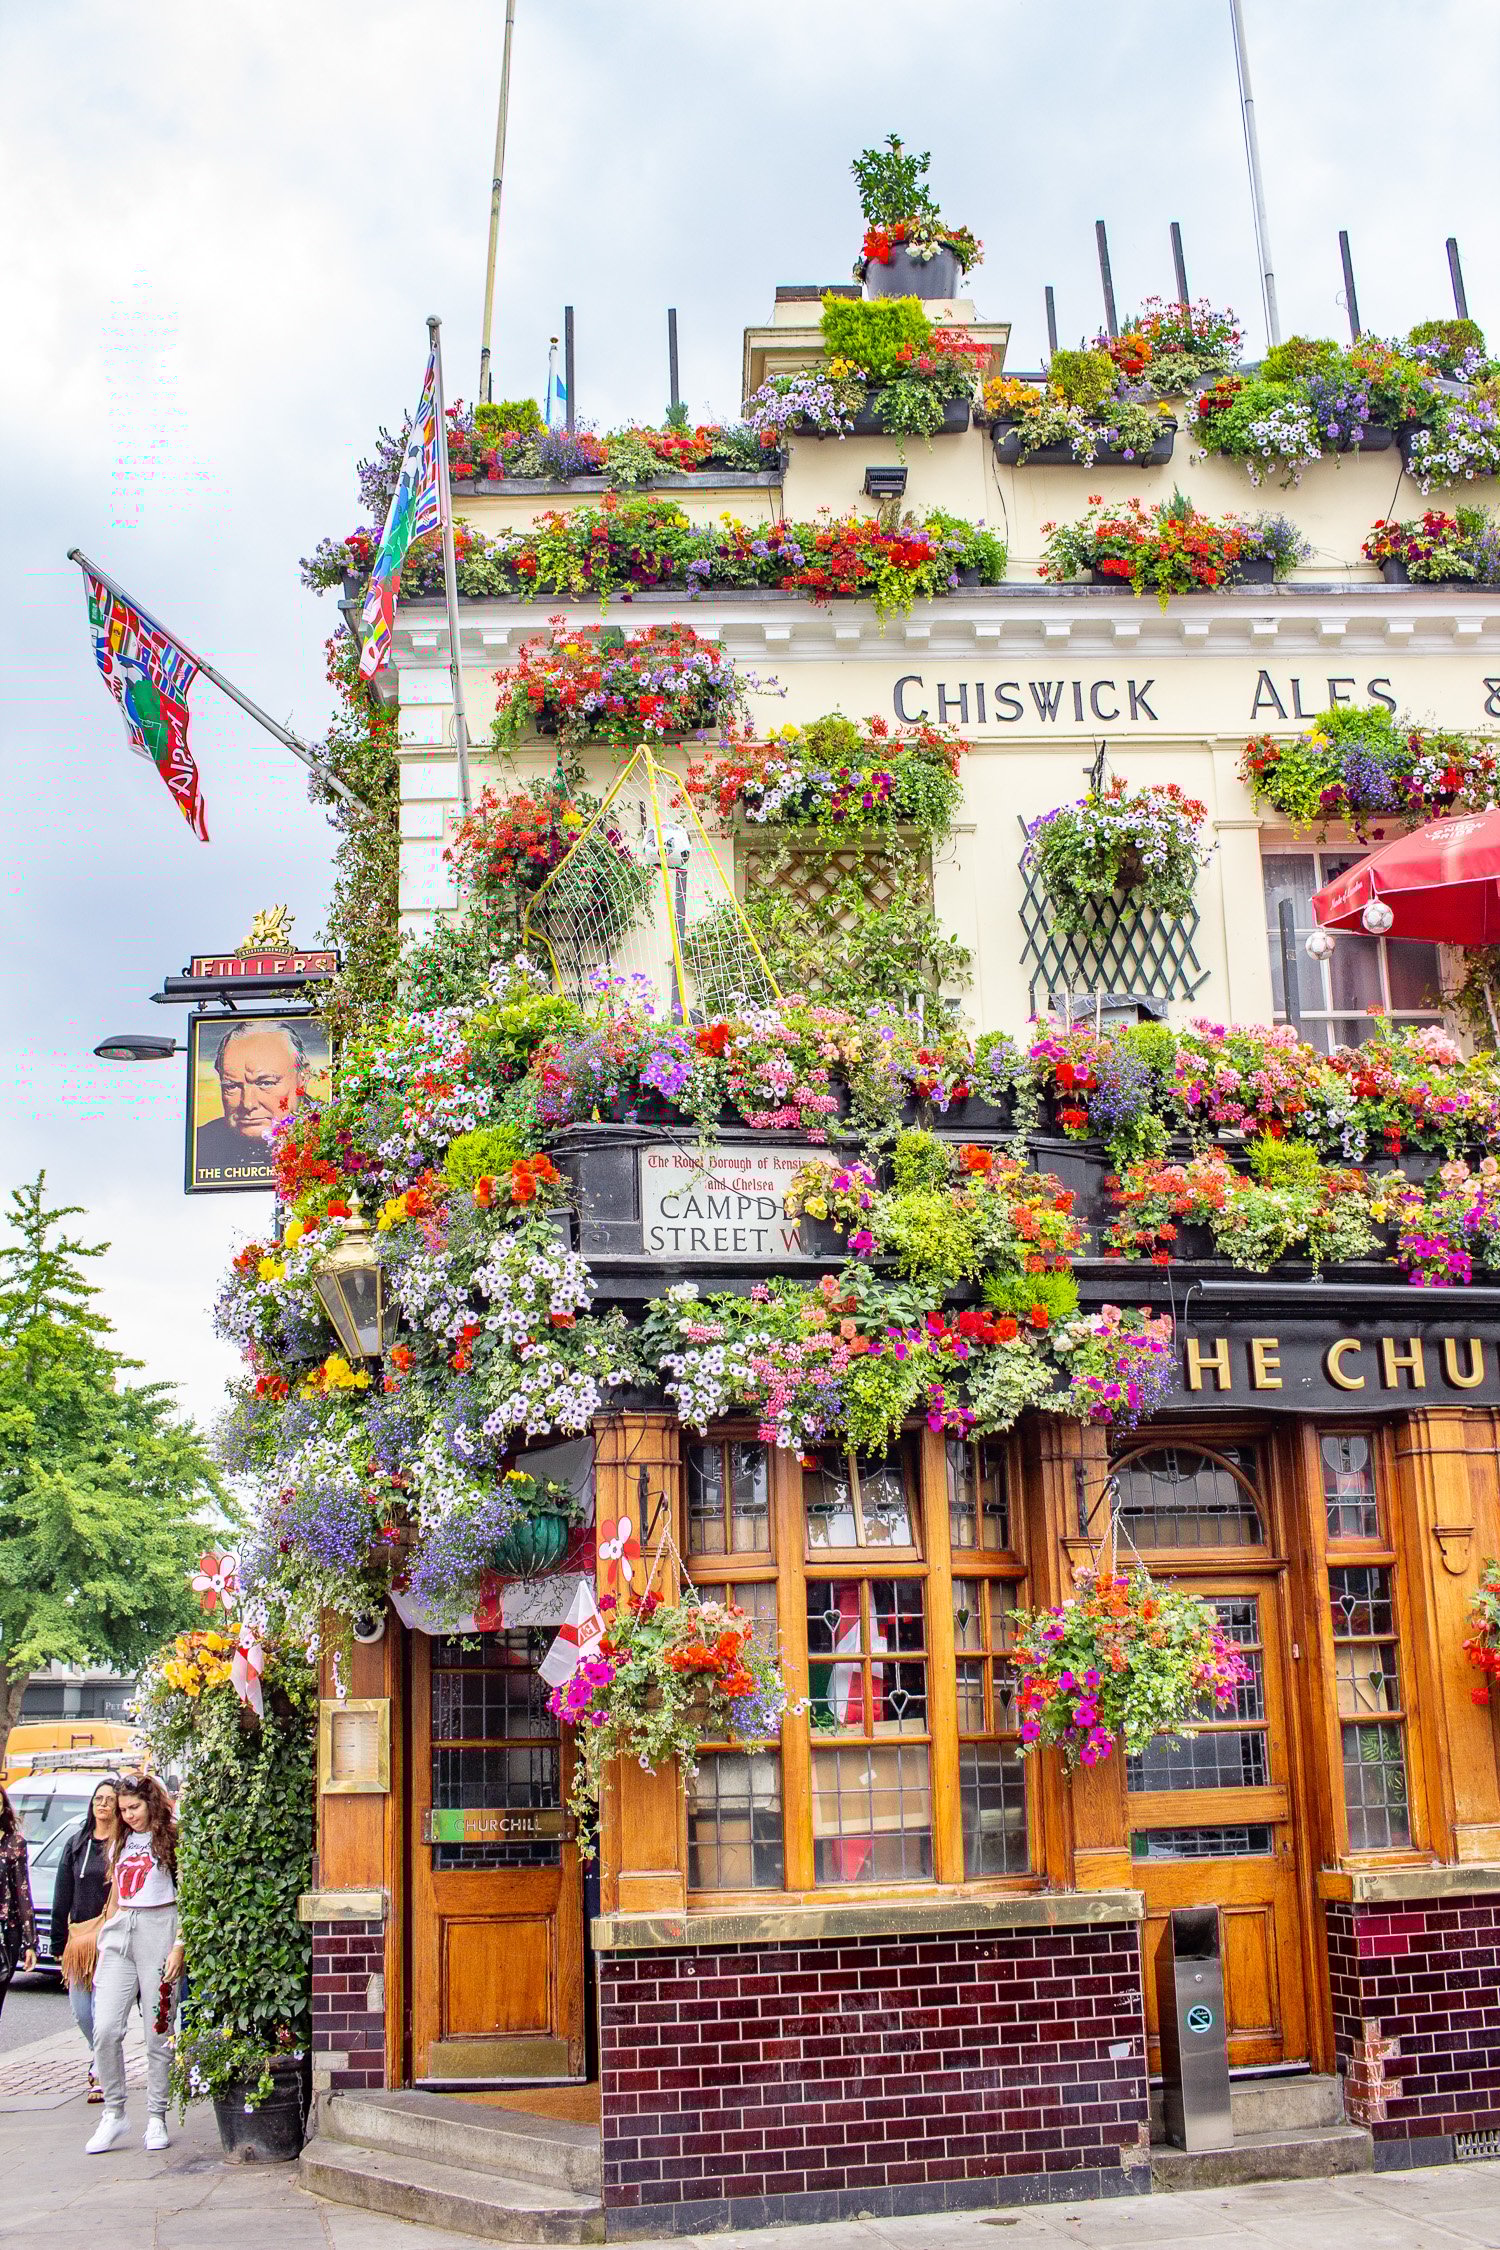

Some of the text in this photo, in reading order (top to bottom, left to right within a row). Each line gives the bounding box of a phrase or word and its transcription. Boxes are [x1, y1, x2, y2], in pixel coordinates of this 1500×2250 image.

[893, 675, 1159, 725] CHISWICK
[1249, 669, 1397, 720] ALES
[1424, 822, 1486, 839] LONDON
[1431, 828, 1474, 841] PRIDE
[648, 1155, 808, 1173] The Royal Borough of Kensi
[198, 1168, 221, 1179] THE
[707, 1177, 774, 1191] and Chelsea
[650, 1226, 774, 1253] STREET,
[105, 1701, 122, 1710] PET
[454, 1815, 543, 1833] CHURCHILL
